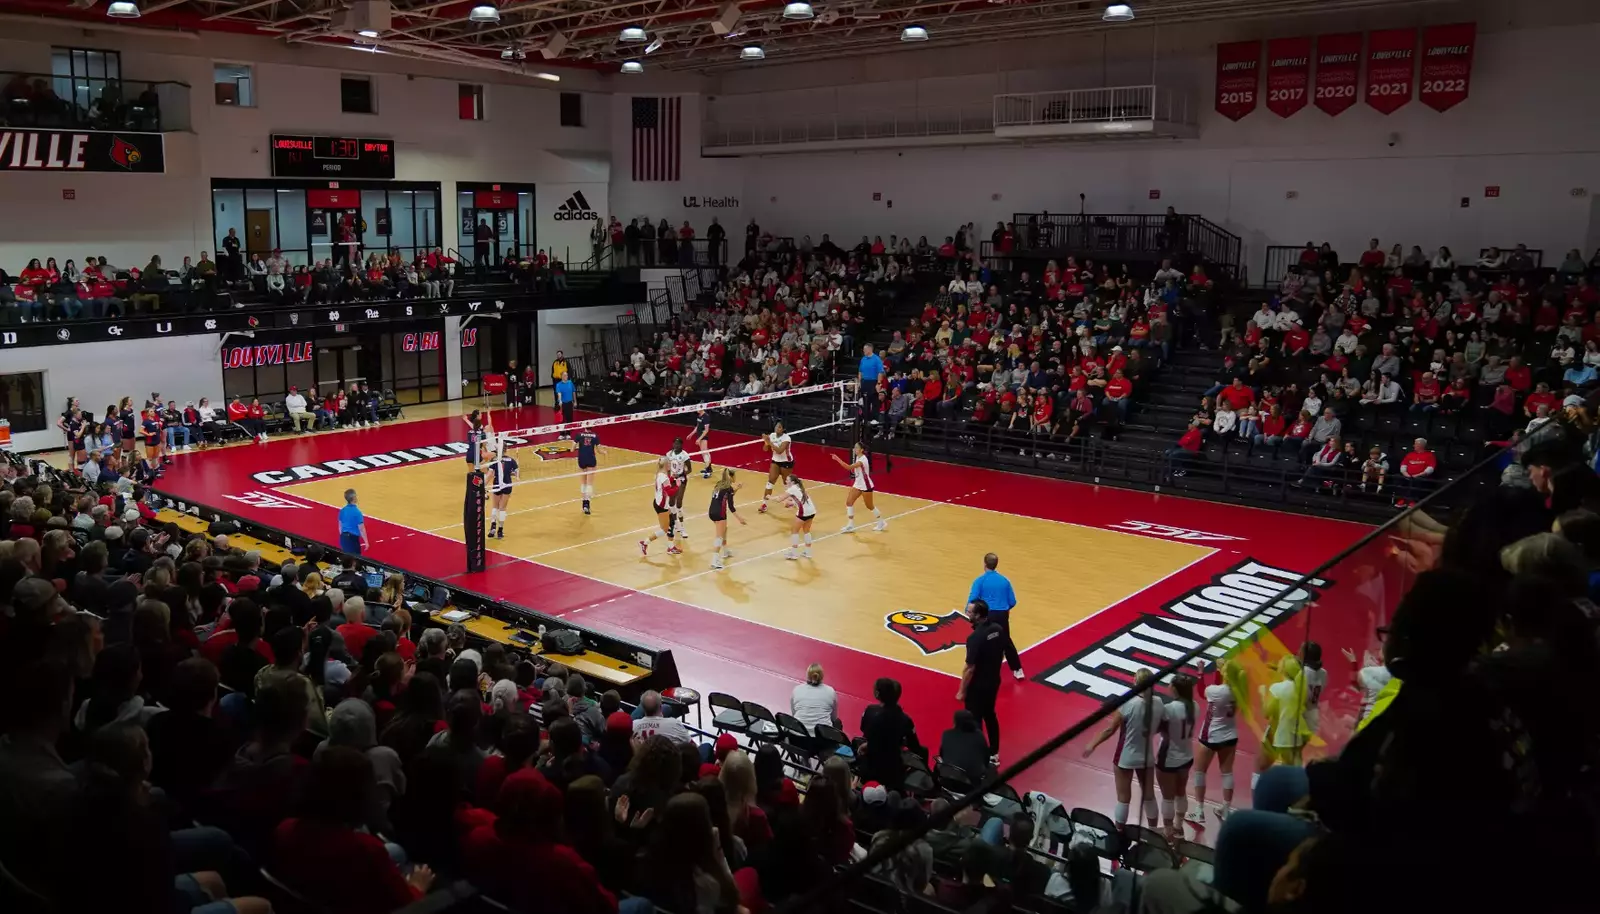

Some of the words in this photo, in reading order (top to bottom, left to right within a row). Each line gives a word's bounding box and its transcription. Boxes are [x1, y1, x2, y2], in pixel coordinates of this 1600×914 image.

[1316, 85, 1355, 98] 2020
[1369, 82, 1408, 96] 2021
[1422, 79, 1466, 93] 2022
[1220, 91, 1253, 104] 2015
[1270, 88, 1304, 102] 2017
[273, 139, 313, 150] LOUISVILLE
[703, 197, 739, 208] Health
[553, 210, 598, 221] adidas
[365, 308, 379, 319] Pitt
[405, 306, 413, 316] S
[156, 321, 172, 333] U
[3, 332, 17, 344] D
[222, 341, 313, 369] LOUISVILLE
[253, 436, 527, 484] CARDINAS
